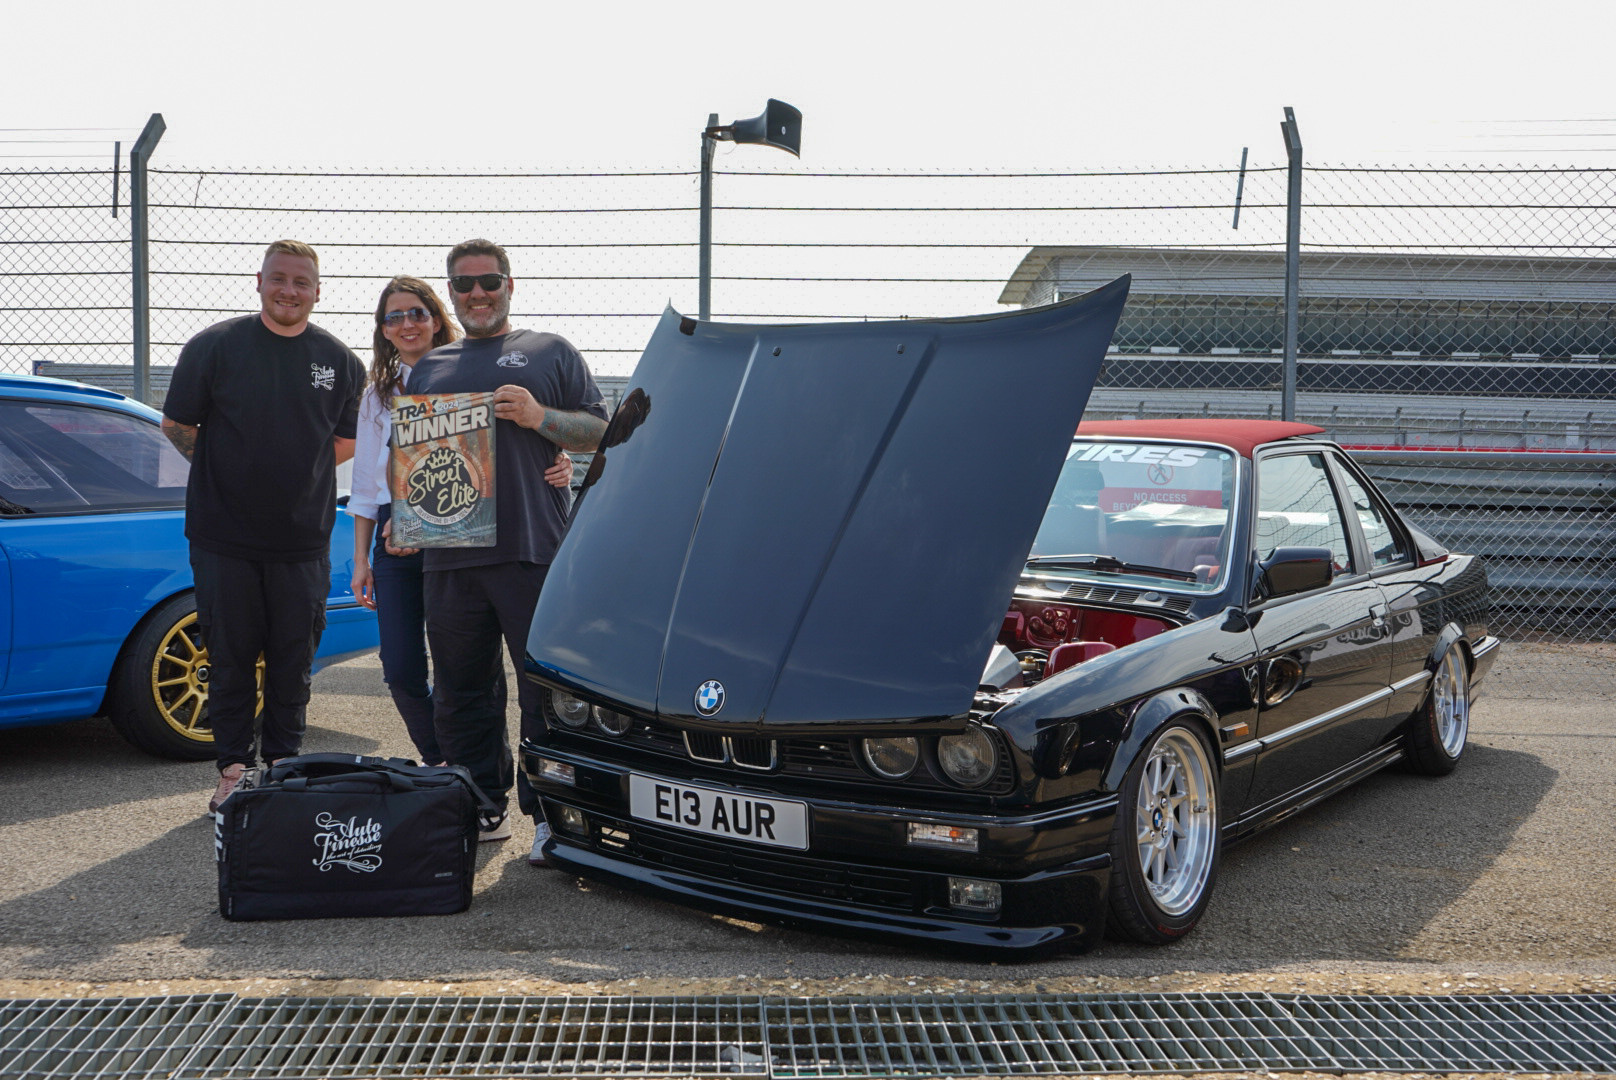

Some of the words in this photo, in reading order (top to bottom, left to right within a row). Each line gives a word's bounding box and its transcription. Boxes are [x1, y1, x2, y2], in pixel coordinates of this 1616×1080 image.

[397, 400, 438, 420] TRAX
[440, 401, 460, 411] 2024
[397, 405, 489, 446] WINNER
[409, 459, 462, 504] Street
[437, 482, 479, 514] Elite
[1133, 492, 1148, 501] NO
[1150, 493, 1187, 503] ACCESS
[416, 508, 442, 524] SILVERSTONE
[700, 681, 724, 694] BMW
[655, 784, 701, 826] E13
[711, 796, 776, 840] AUR
[326, 814, 382, 840] Auto
[313, 832, 381, 863] Finesse
